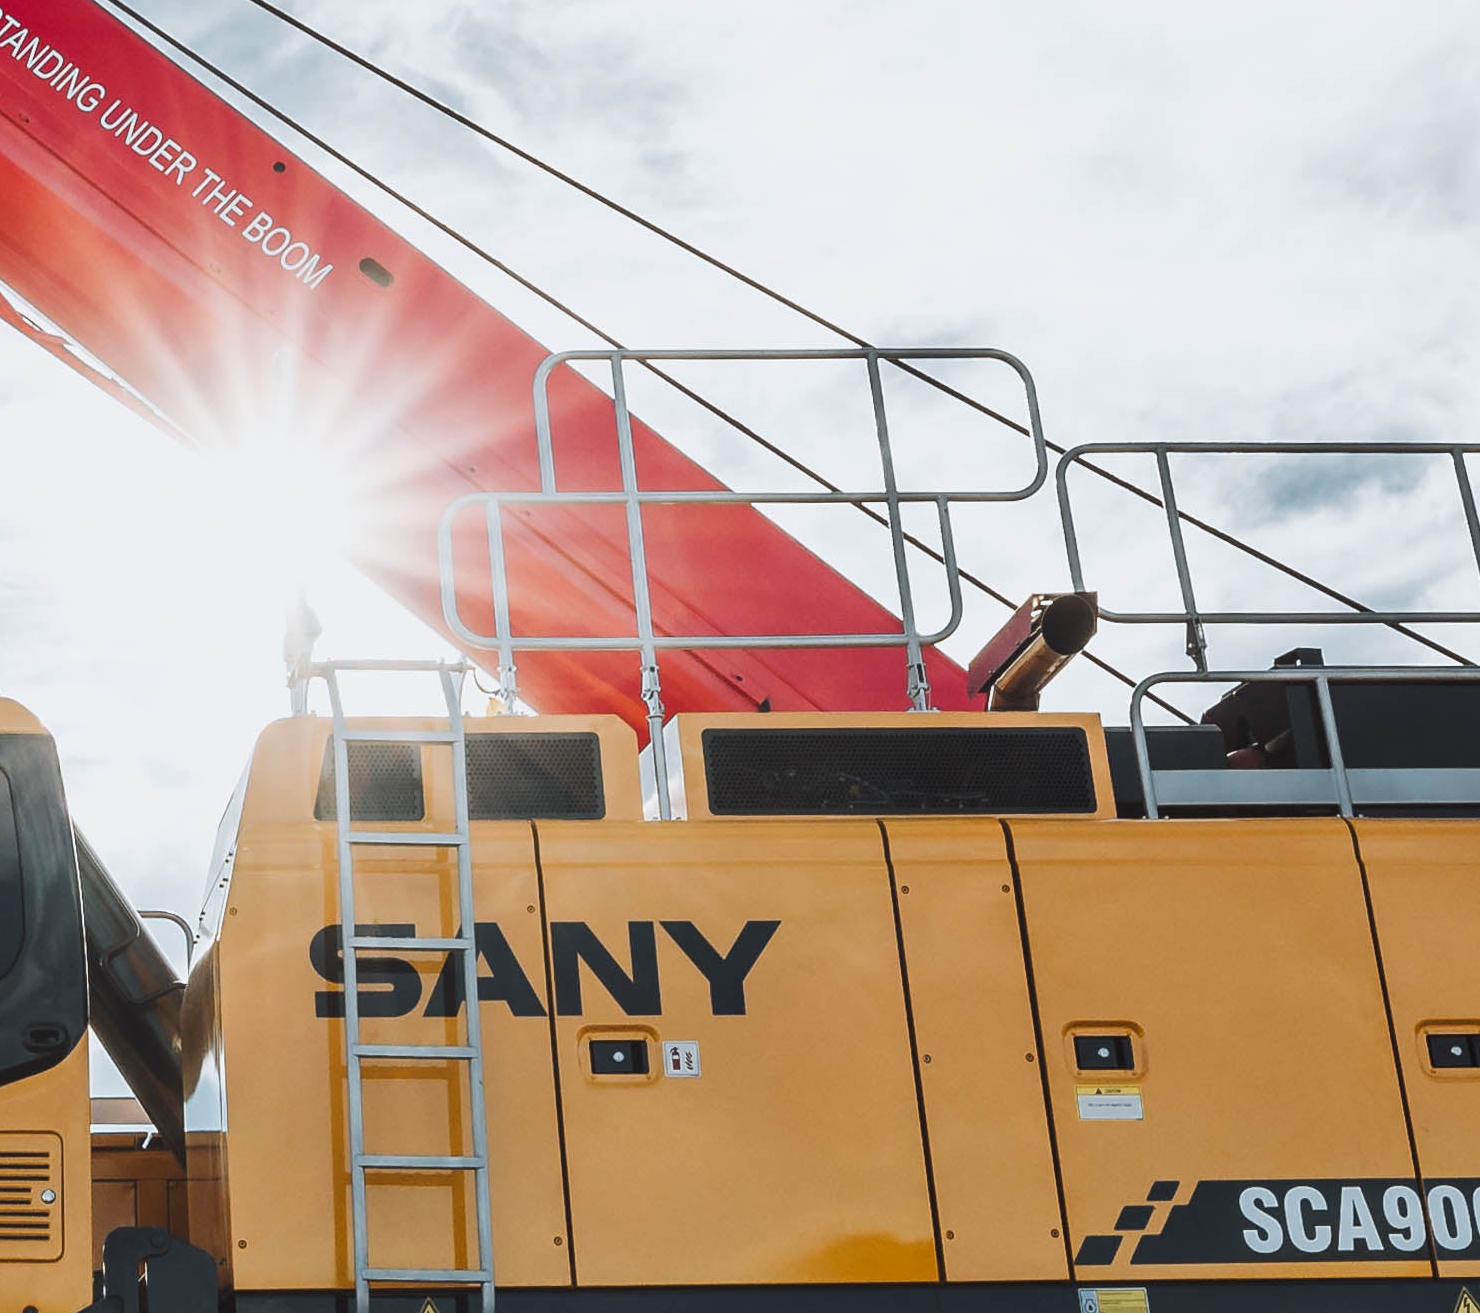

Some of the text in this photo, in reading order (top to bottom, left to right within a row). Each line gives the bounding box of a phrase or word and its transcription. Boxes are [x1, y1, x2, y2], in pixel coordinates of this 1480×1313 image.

[100, 99, 197, 185] UNDER
[191, 168, 253, 227] THE
[242, 211, 334, 289] BOOM
[308, 920, 783, 1018] SANY
